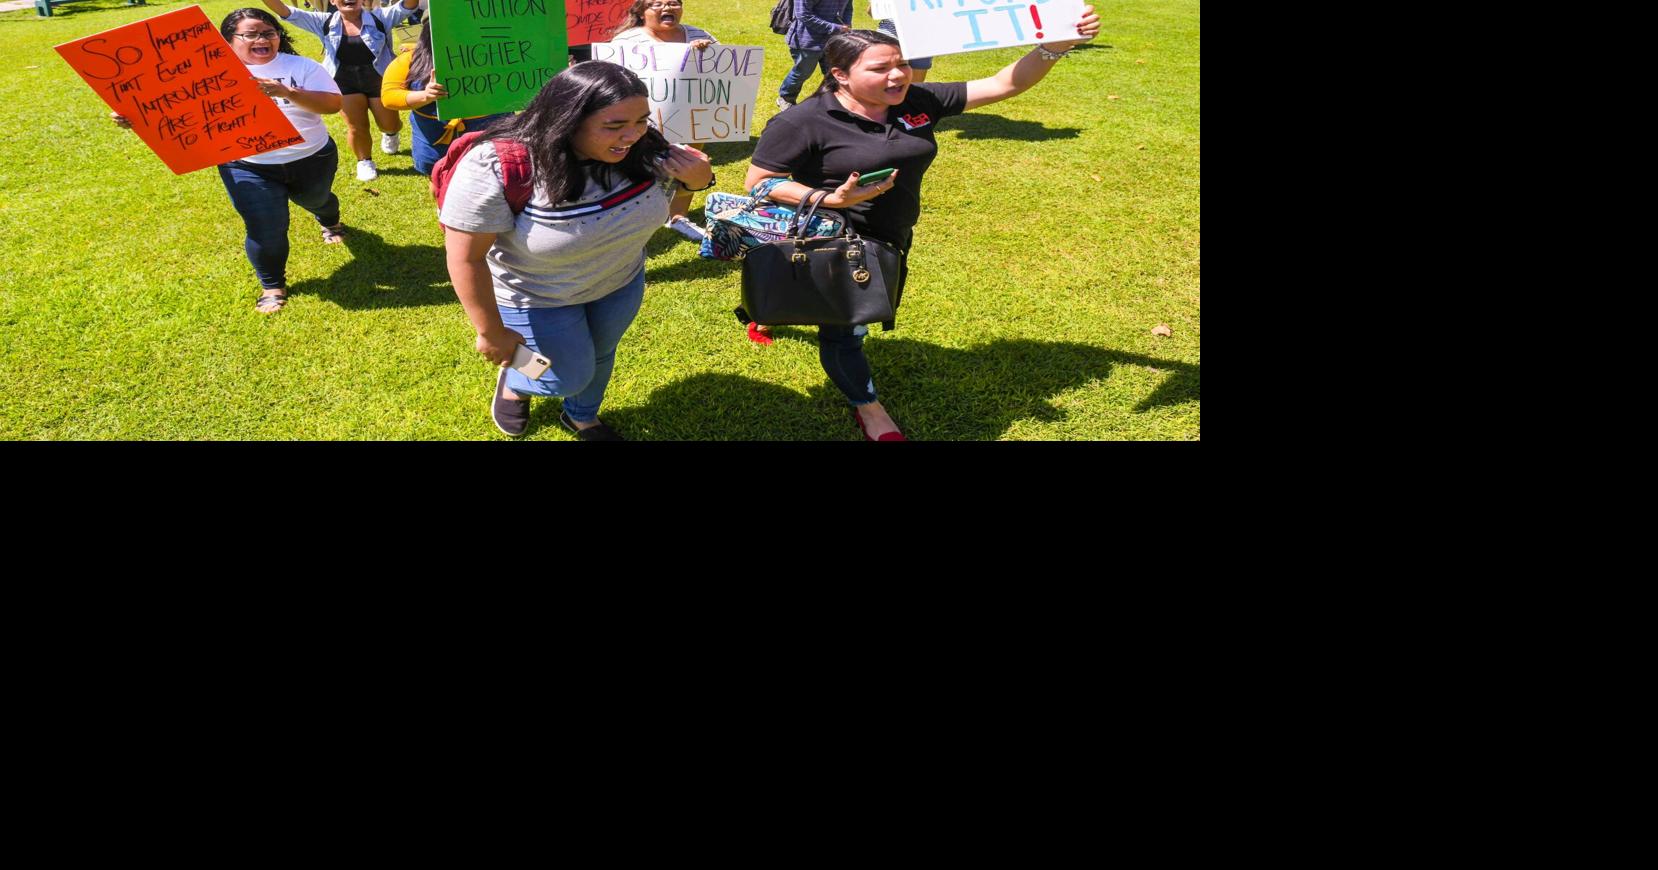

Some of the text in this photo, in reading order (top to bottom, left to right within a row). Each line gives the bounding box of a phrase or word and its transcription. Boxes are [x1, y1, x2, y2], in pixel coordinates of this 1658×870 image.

[464, 0, 547, 19] TUITION
[953, 4, 1044, 49] IT!
[81, 39, 143, 80] SO
[195, 42, 228, 67] THE
[446, 40, 537, 71] HIGHER
[680, 44, 763, 77] ABOVE
[133, 71, 238, 127] INTROVERTS
[445, 73, 501, 99] DROP
[158, 93, 245, 140] ARE HERE
[174, 132, 198, 150] TO
